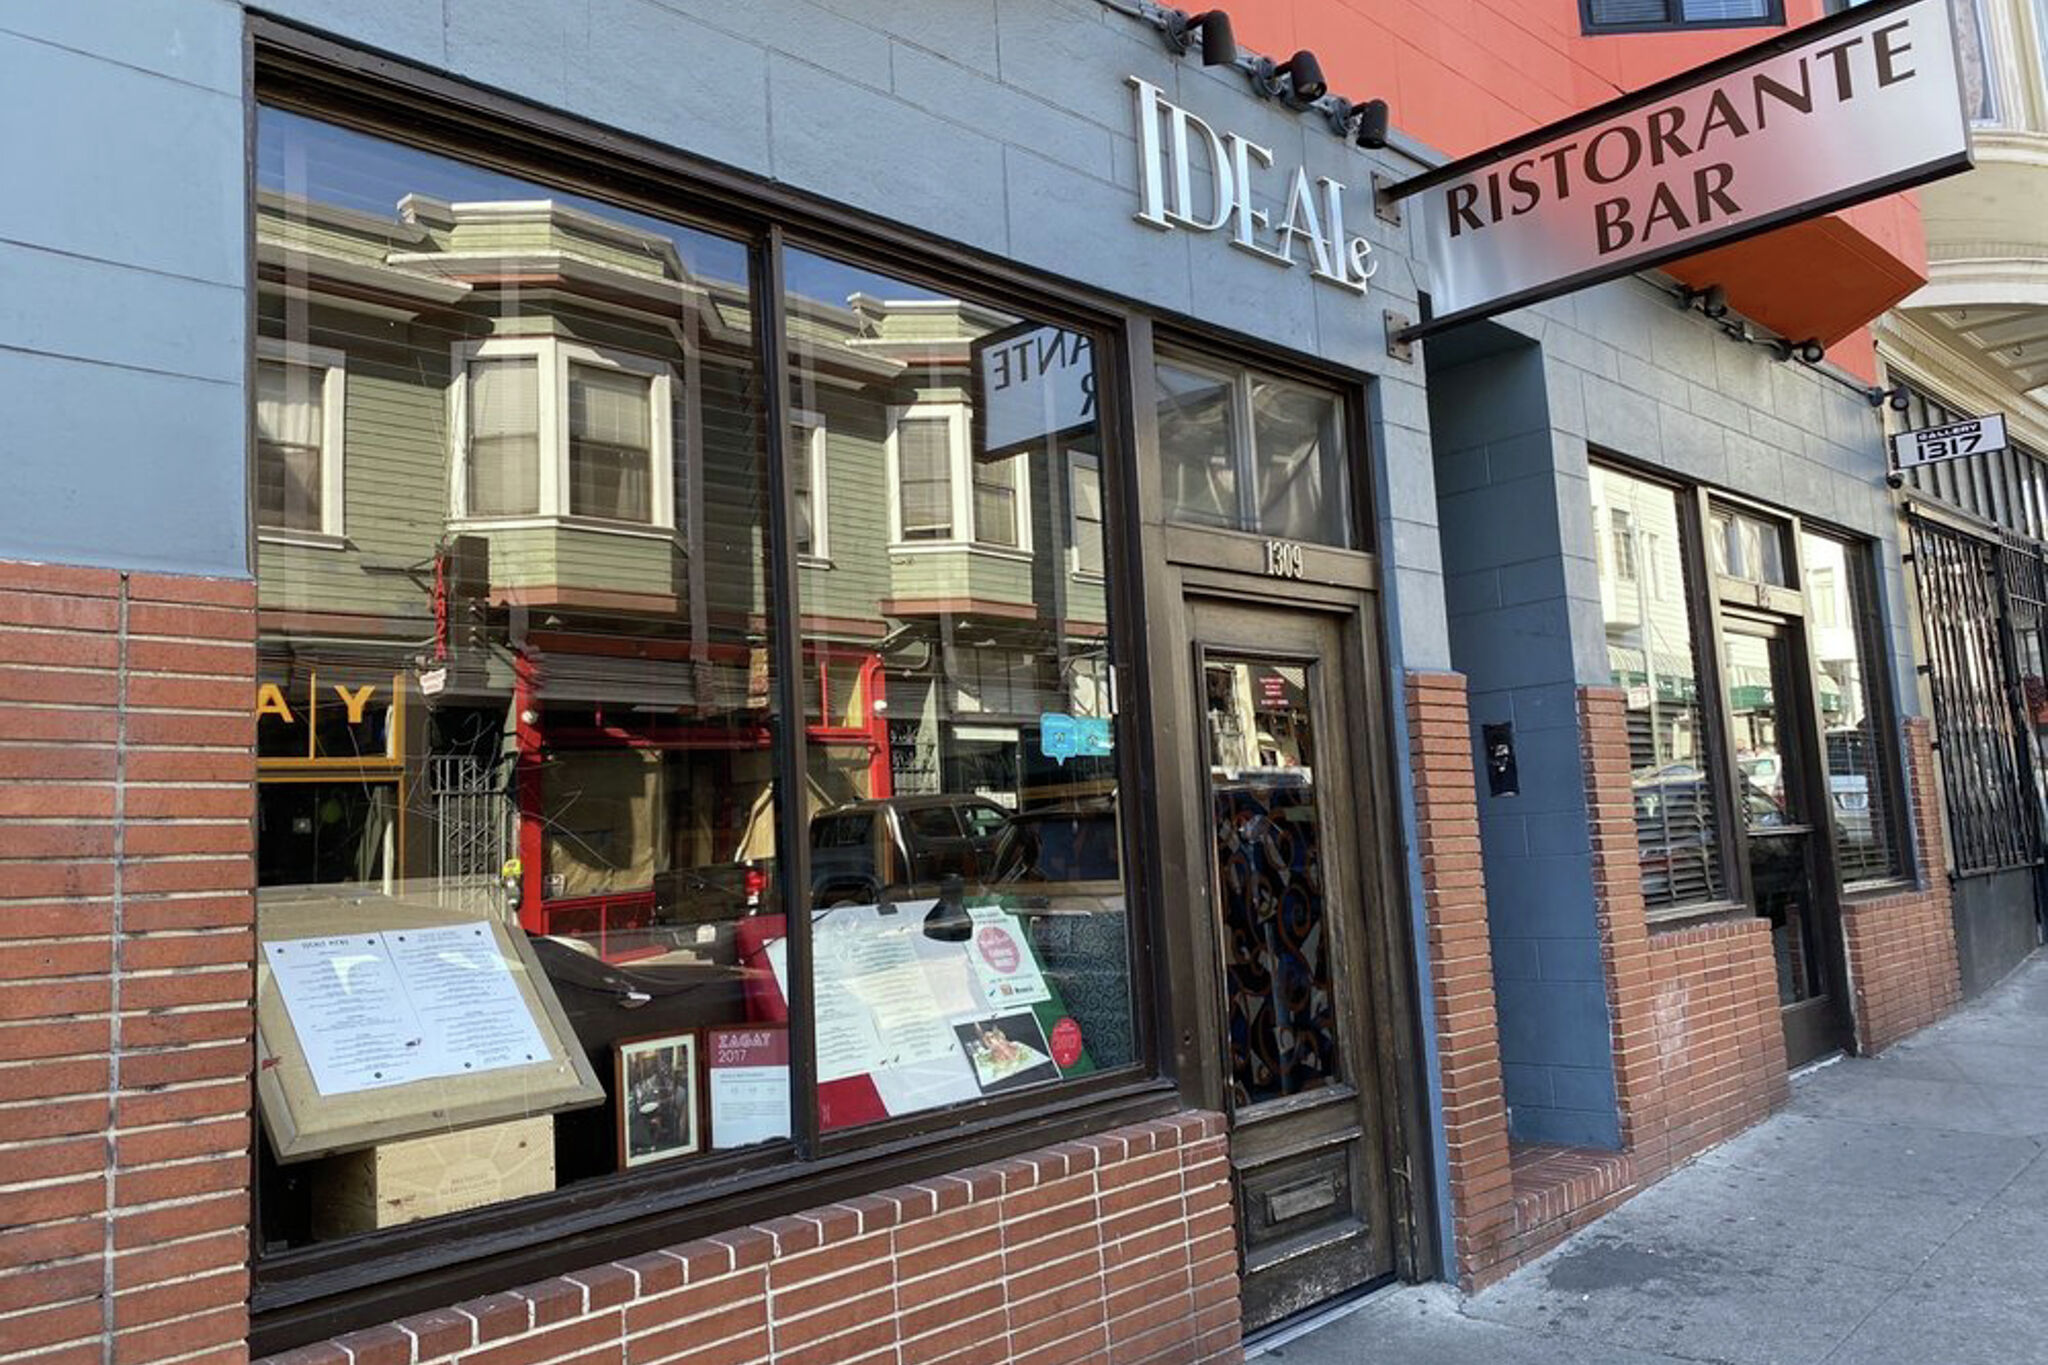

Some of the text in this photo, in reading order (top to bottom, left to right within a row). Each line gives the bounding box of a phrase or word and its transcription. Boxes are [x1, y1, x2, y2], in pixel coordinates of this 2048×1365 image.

[1446, 19, 1916, 237] RISTORANTE
[1593, 161, 1742, 255] BAR
[1917, 422, 1979, 442] GALLERY
[1916, 434, 1983, 461] 1317
[1266, 540, 1304, 579] 1309
[718, 1032, 771, 1049] ZAGAT
[717, 1048, 747, 1064] 2017
